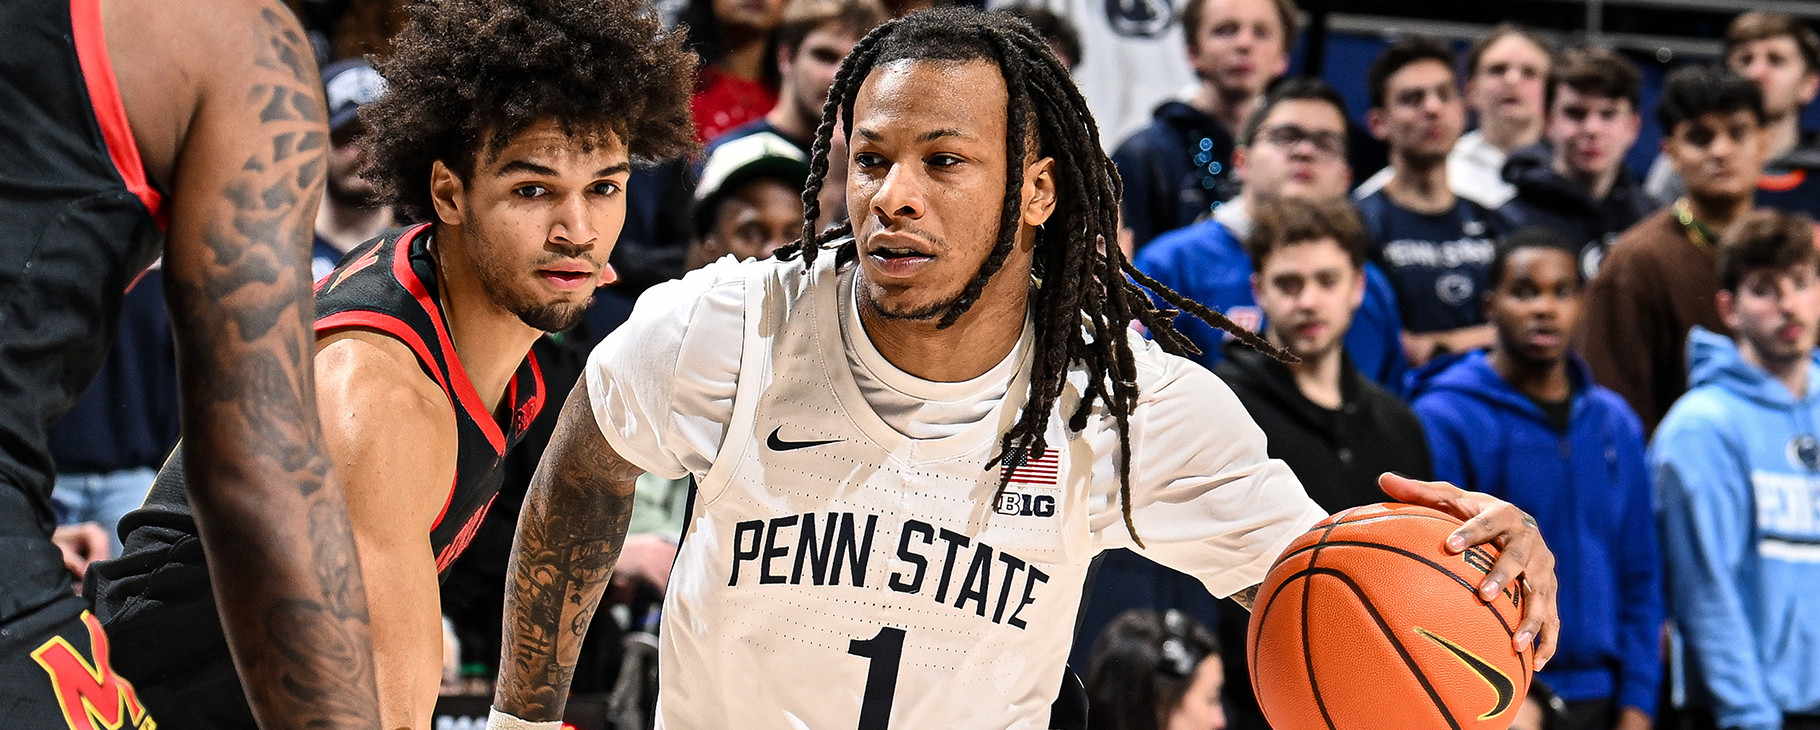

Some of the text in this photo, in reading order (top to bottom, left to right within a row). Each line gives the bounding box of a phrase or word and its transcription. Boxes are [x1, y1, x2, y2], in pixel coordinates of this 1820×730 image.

[727, 511, 1050, 630] PENN STATE
[847, 626, 906, 730] 1
